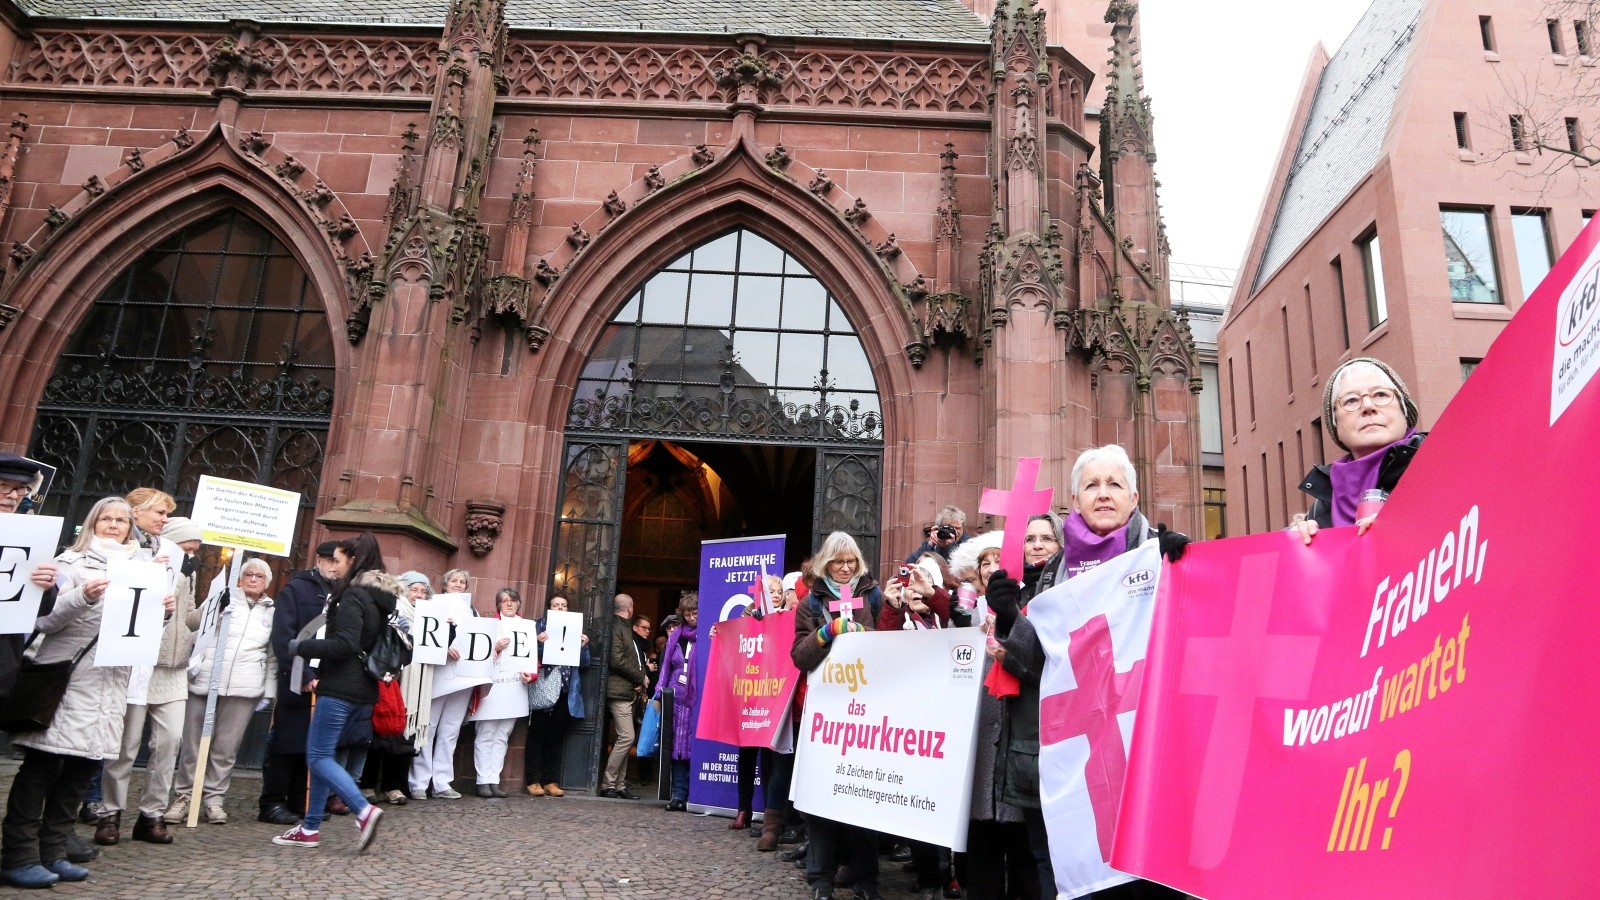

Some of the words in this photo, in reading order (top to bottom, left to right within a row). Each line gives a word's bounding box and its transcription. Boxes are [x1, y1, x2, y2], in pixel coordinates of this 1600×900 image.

[1567, 267, 1600, 336] kfd
[1559, 357, 1572, 380] die
[216, 486, 237, 495] Garten
[249, 492, 266, 500] Kirche
[725, 571, 757, 583] JETZT!
[1128, 571, 1149, 585] kfd
[1360, 504, 1488, 658] Frauen,
[121, 587, 147, 638] I
[418, 615, 443, 649] R
[510, 630, 531, 658] E
[559, 625, 567, 651] !
[464, 632, 493, 661] D
[956, 648, 972, 661] kfd
[745, 662, 760, 675] das
[822, 656, 868, 692] Tragt
[1283, 665, 1384, 746] worauf
[1378, 611, 1471, 723] wartet
[847, 698, 866, 716] das
[810, 712, 946, 759] Purpurkreuz
[702, 762, 710, 770] IN
[710, 762, 722, 771] DER
[718, 753, 739, 762] FRAUE
[699, 772, 707, 780] IM
[708, 773, 731, 783] BISTUM
[835, 762, 846, 775] als
[846, 764, 874, 780] Zeichen
[875, 767, 886, 782] für
[887, 770, 904, 785] eine
[833, 782, 908, 807] geschlechtergerechte
[910, 794, 936, 811] Kirche
[1326, 748, 1412, 852] Ihr?
